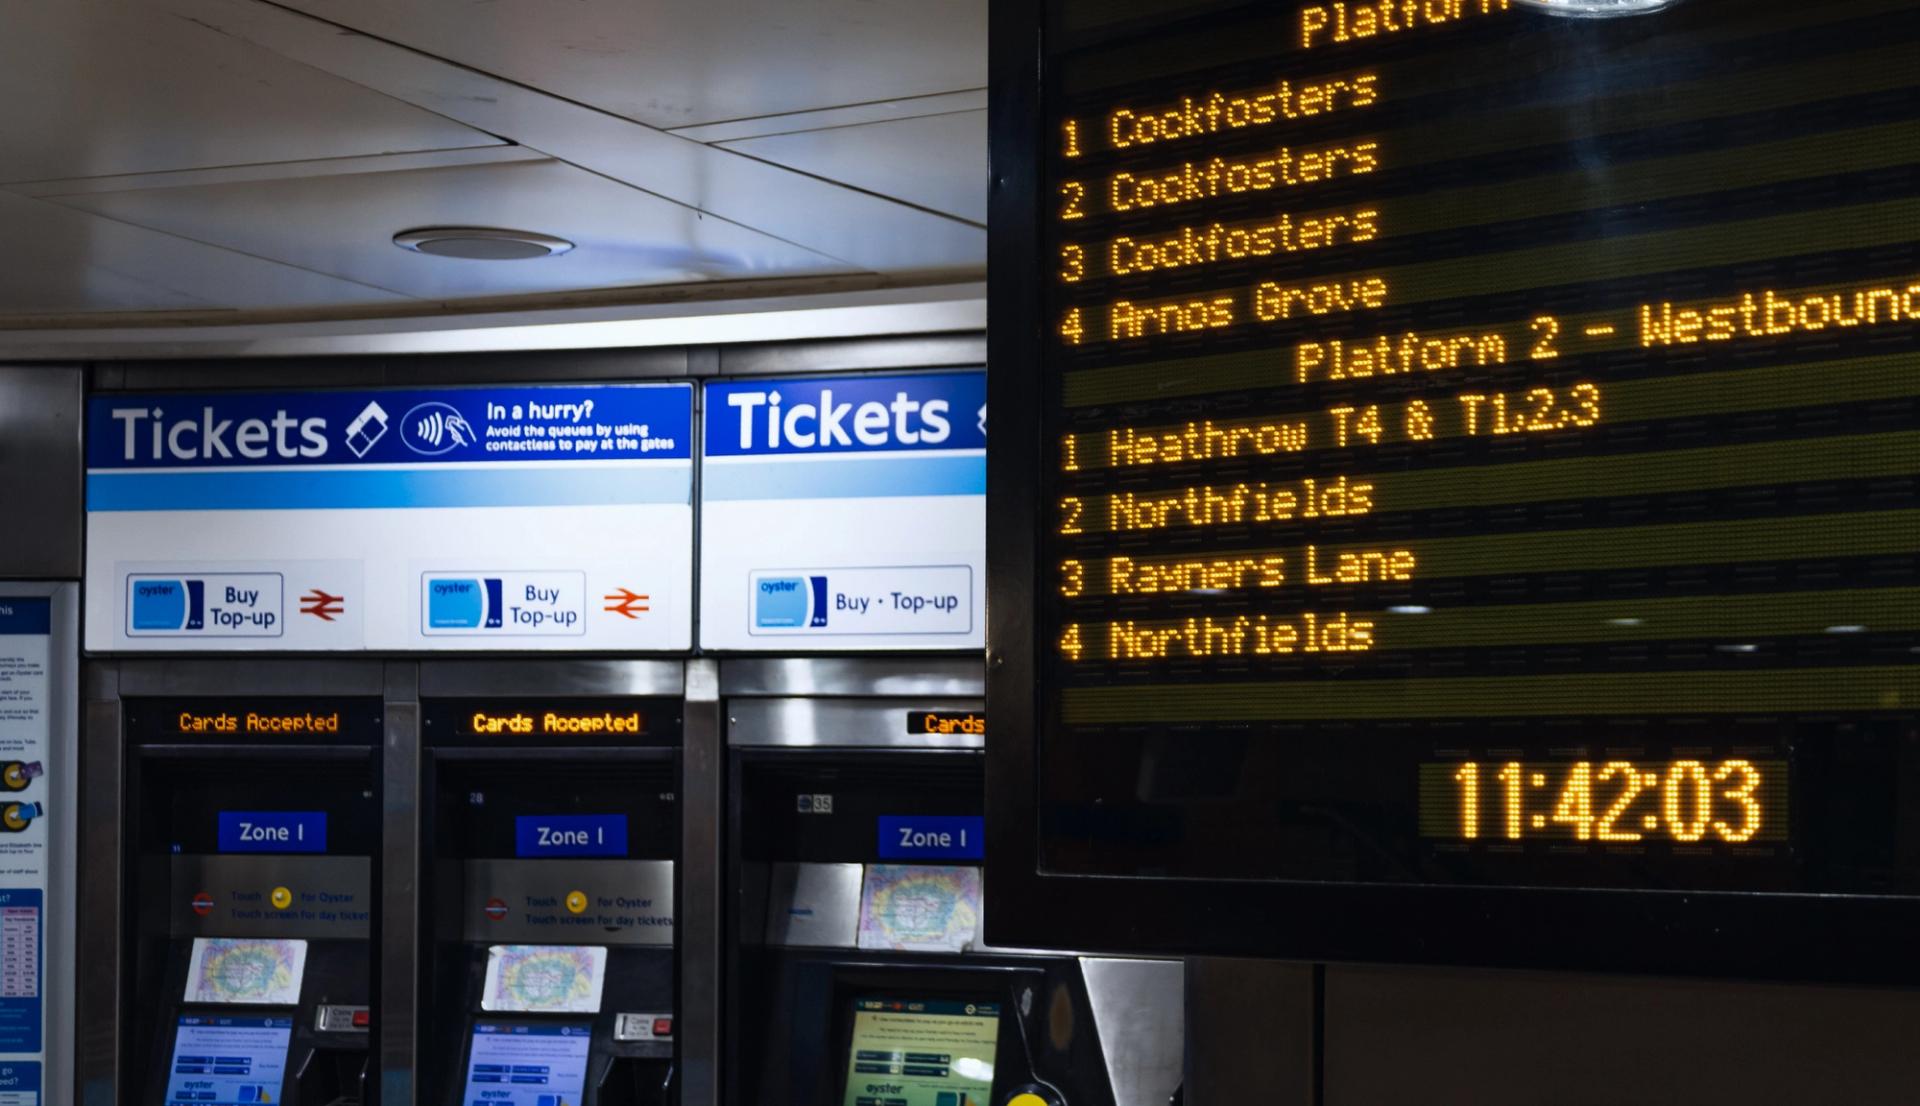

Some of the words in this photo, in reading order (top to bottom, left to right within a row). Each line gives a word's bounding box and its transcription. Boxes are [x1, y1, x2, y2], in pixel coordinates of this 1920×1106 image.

[1302, 0, 1508, 48] Platfo
[1065, 120, 1080, 156] 1
[1111, 75, 1377, 148] Cockfosters
[1062, 182, 1084, 219] 2
[1111, 142, 1378, 211] Cockfosters
[1062, 245, 1083, 282] 3
[1111, 209, 1378, 275] Cockfosters
[1061, 307, 1083, 344] 4
[1111, 298, 1234, 340] Arnos
[1256, 278, 1388, 321] Grove
[1299, 332, 1505, 383] Platform
[1531, 316, 1558, 359] 2
[487, 402, 505, 420] In
[512, 405, 523, 420] a
[529, 400, 594, 422] hurry?
[728, 389, 951, 449] Tickets
[112, 406, 329, 460] Tickets
[486, 425, 521, 437] Avoid
[524, 424, 545, 437] the
[548, 425, 593, 438] queues
[596, 424, 612, 438] by
[614, 424, 649, 438] using
[1064, 434, 1080, 471] 1
[1111, 420, 1307, 467] Heathrow
[1330, 405, 1384, 447] T4
[1406, 400, 1433, 440] &
[486, 438, 555, 452] contactless
[558, 439, 572, 451] to
[575, 440, 597, 453] pay
[600, 439, 613, 450] at
[616, 438, 638, 450] the
[640, 438, 674, 452] gates
[1061, 497, 1083, 535] 2
[1111, 475, 1374, 531] Northfields
[1061, 560, 1083, 597] 3
[1111, 556, 1285, 595] Rayners
[1308, 545, 1415, 585] Lane
[139, 585, 174, 597] oyster
[225, 587, 259, 606] Buy
[434, 583, 471, 596] oyster
[526, 585, 560, 604] Buy
[761, 581, 798, 594] oyster
[836, 593, 870, 614] Buy
[891, 592, 958, 613] Top-up
[210, 608, 275, 629] Top-up
[510, 607, 577, 627] Top-up
[1061, 623, 1083, 660] 4
[1111, 611, 1375, 659] Northfields
[179, 712, 237, 732] Cards
[247, 711, 338, 732] Accepted
[473, 713, 533, 733] Cards
[544, 712, 639, 733] Accepted
[925, 714, 985, 734] Cards
[1455, 760, 1761, 842] 11:42:03
[239, 823, 289, 841] Zone
[537, 827, 589, 846] Zone
[899, 828, 951, 847] Zone
[232, 891, 261, 901] Touch
[302, 891, 315, 901] for
[320, 892, 353, 903] Oyster
[526, 896, 557, 906] Touch
[598, 896, 612, 907] for
[616, 897, 652, 909] Oyster
[232, 909, 261, 919] Touch
[264, 911, 298, 920] screen
[301, 909, 315, 919] for
[319, 910, 336, 922] day
[526, 914, 557, 925] Touch
[560, 916, 594, 925] screen
[598, 914, 613, 925] for
[617, 915, 634, 927] day
[638, 915, 673, 926] tickets
